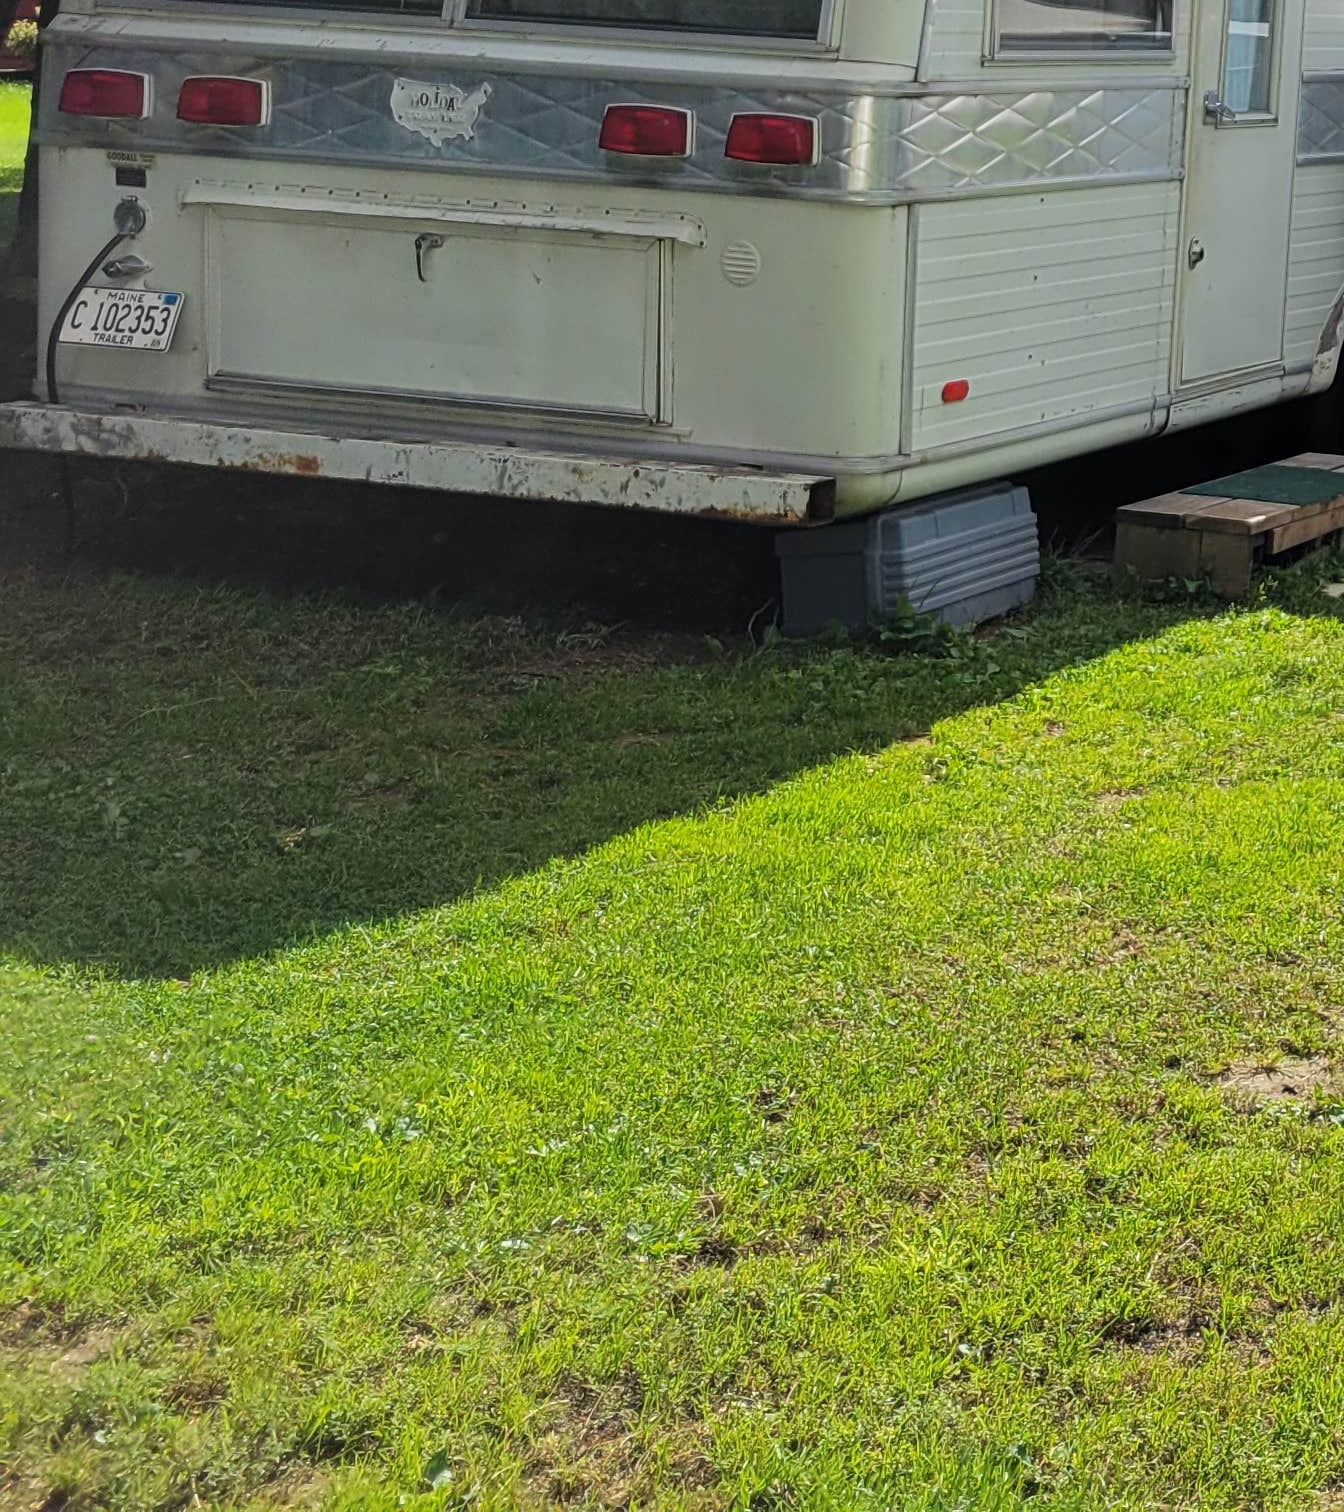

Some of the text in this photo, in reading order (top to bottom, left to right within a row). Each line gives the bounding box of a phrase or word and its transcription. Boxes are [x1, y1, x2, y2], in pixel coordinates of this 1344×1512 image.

[106, 291, 145, 303] MAINE
[70, 300, 171, 336] C 102353
[93, 332, 134, 346] TRAILER
